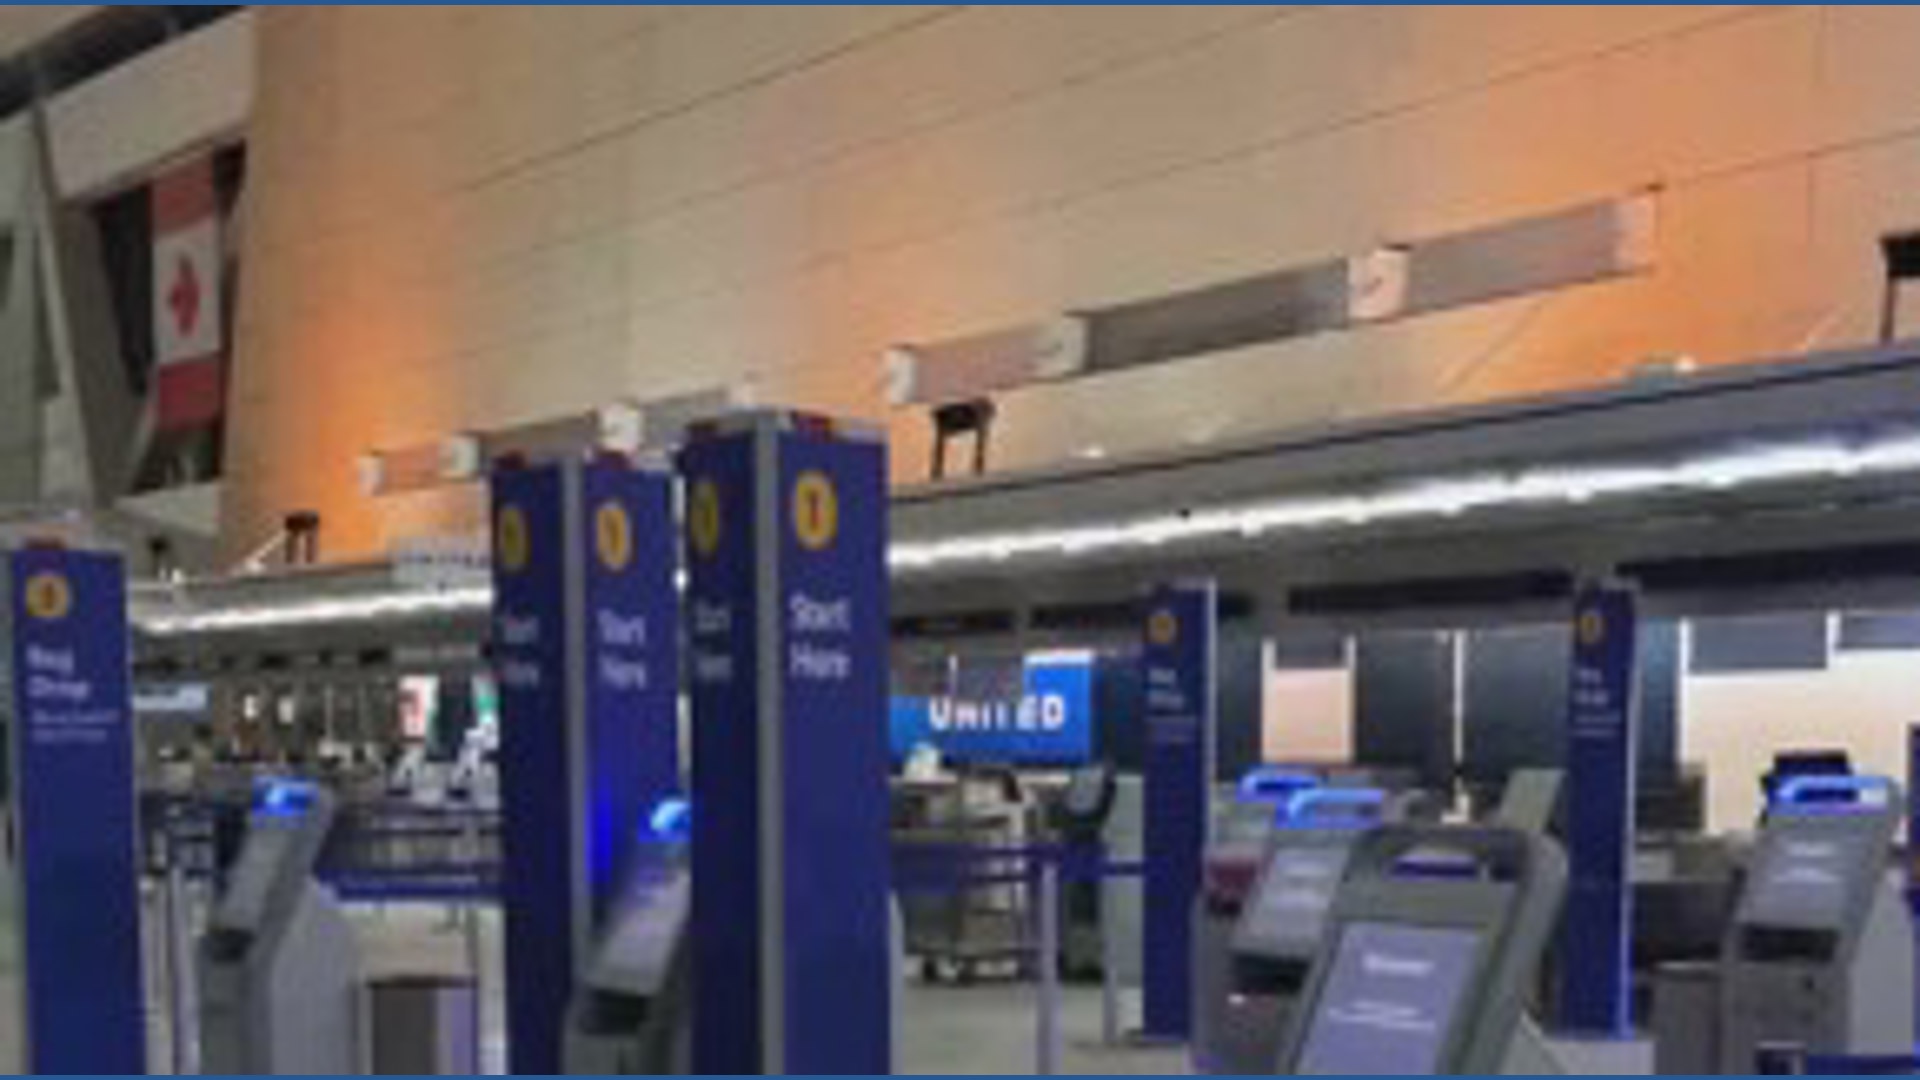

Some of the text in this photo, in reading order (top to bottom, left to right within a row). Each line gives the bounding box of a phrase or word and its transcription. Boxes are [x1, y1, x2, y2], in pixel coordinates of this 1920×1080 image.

[790, 592, 850, 633] Start
[790, 641, 850, 681] Here
[928, 693, 1065, 731] UNITED
